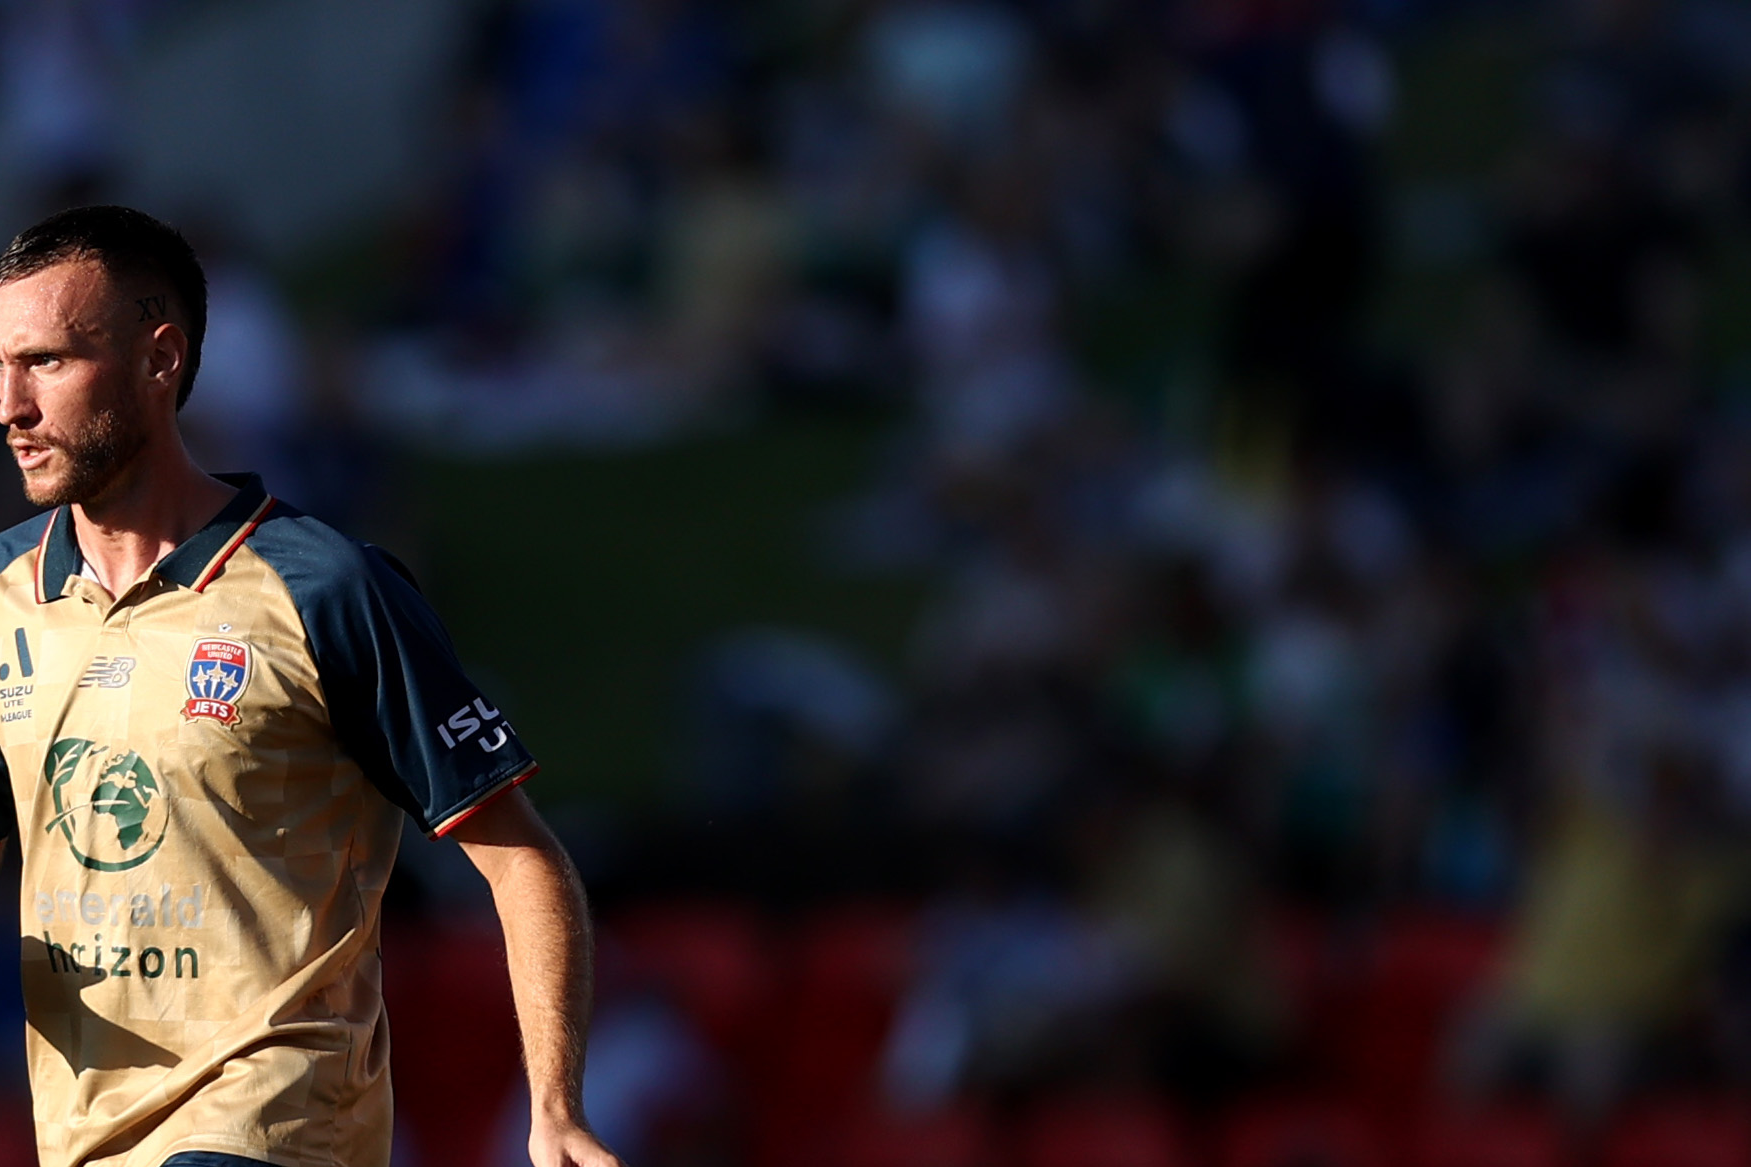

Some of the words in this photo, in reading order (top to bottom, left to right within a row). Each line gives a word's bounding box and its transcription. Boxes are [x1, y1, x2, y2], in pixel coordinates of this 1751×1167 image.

[136, 295, 165, 321] XV
[202, 643, 243, 656] NEWCASTLE
[207, 651, 233, 660] UNITED
[3, 698, 24, 708] UTE
[191, 701, 228, 718] JETS
